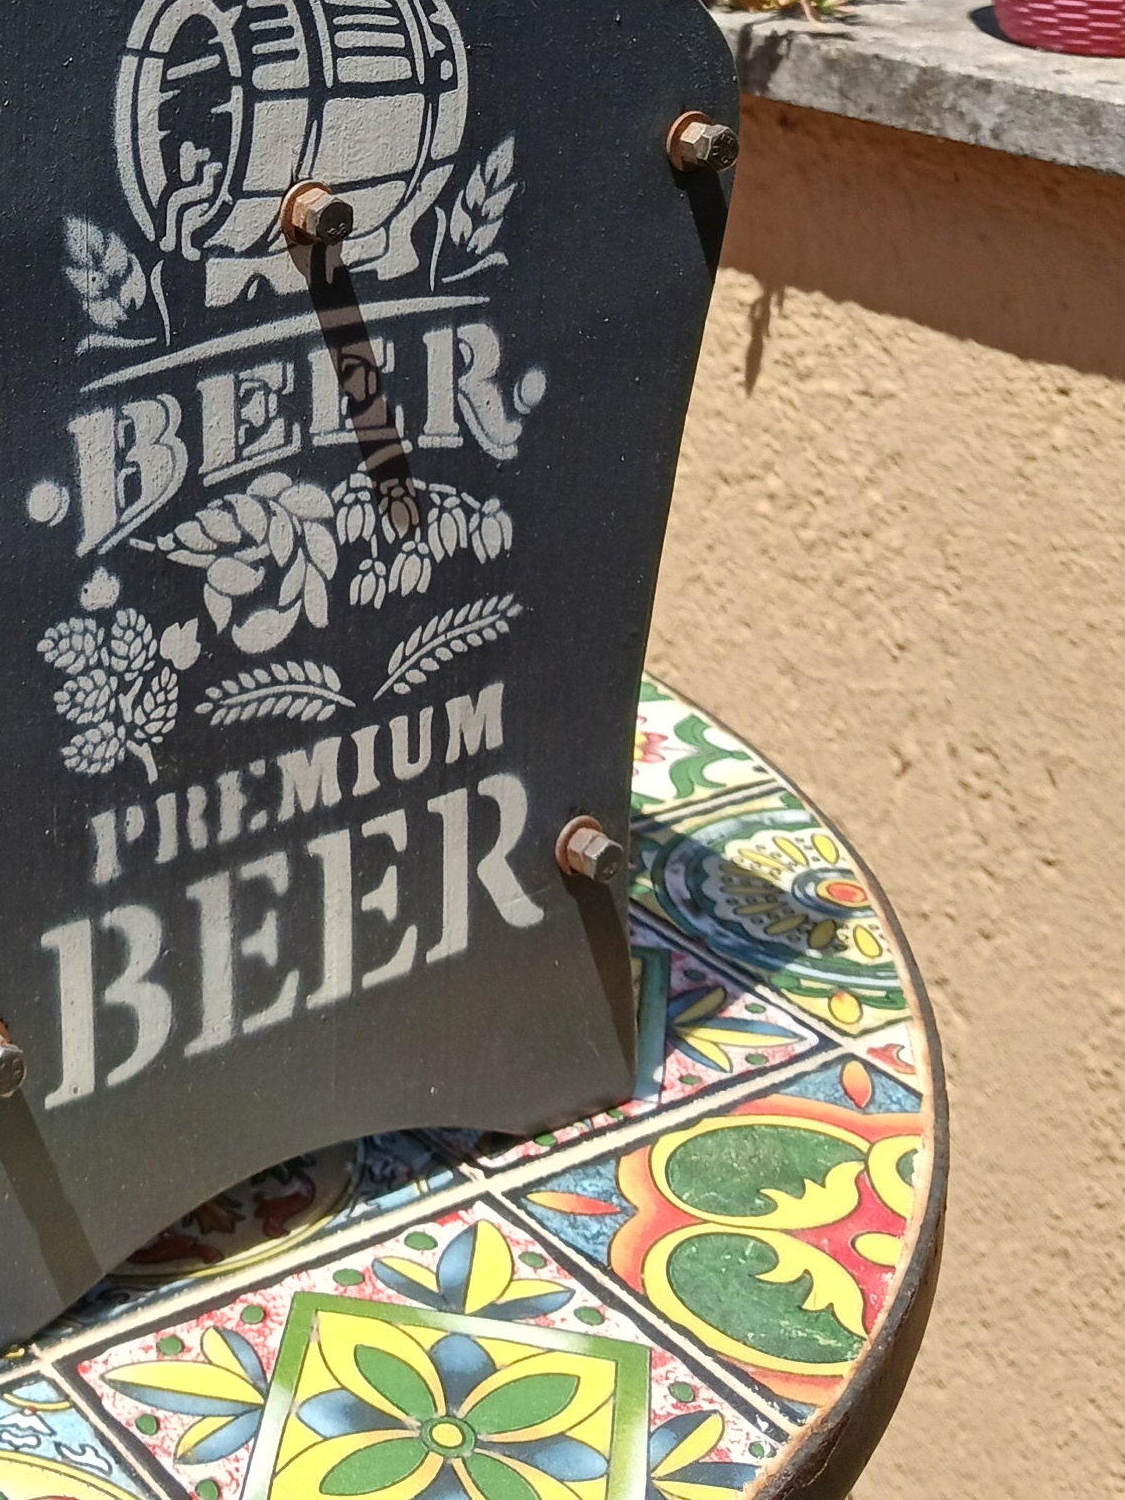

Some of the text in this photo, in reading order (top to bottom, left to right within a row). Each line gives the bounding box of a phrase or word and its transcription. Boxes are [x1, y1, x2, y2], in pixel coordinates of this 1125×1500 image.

[67, 322, 521, 558] BEER
[90, 682, 505, 884] PREMIUM
[41, 772, 546, 1111] BEER
